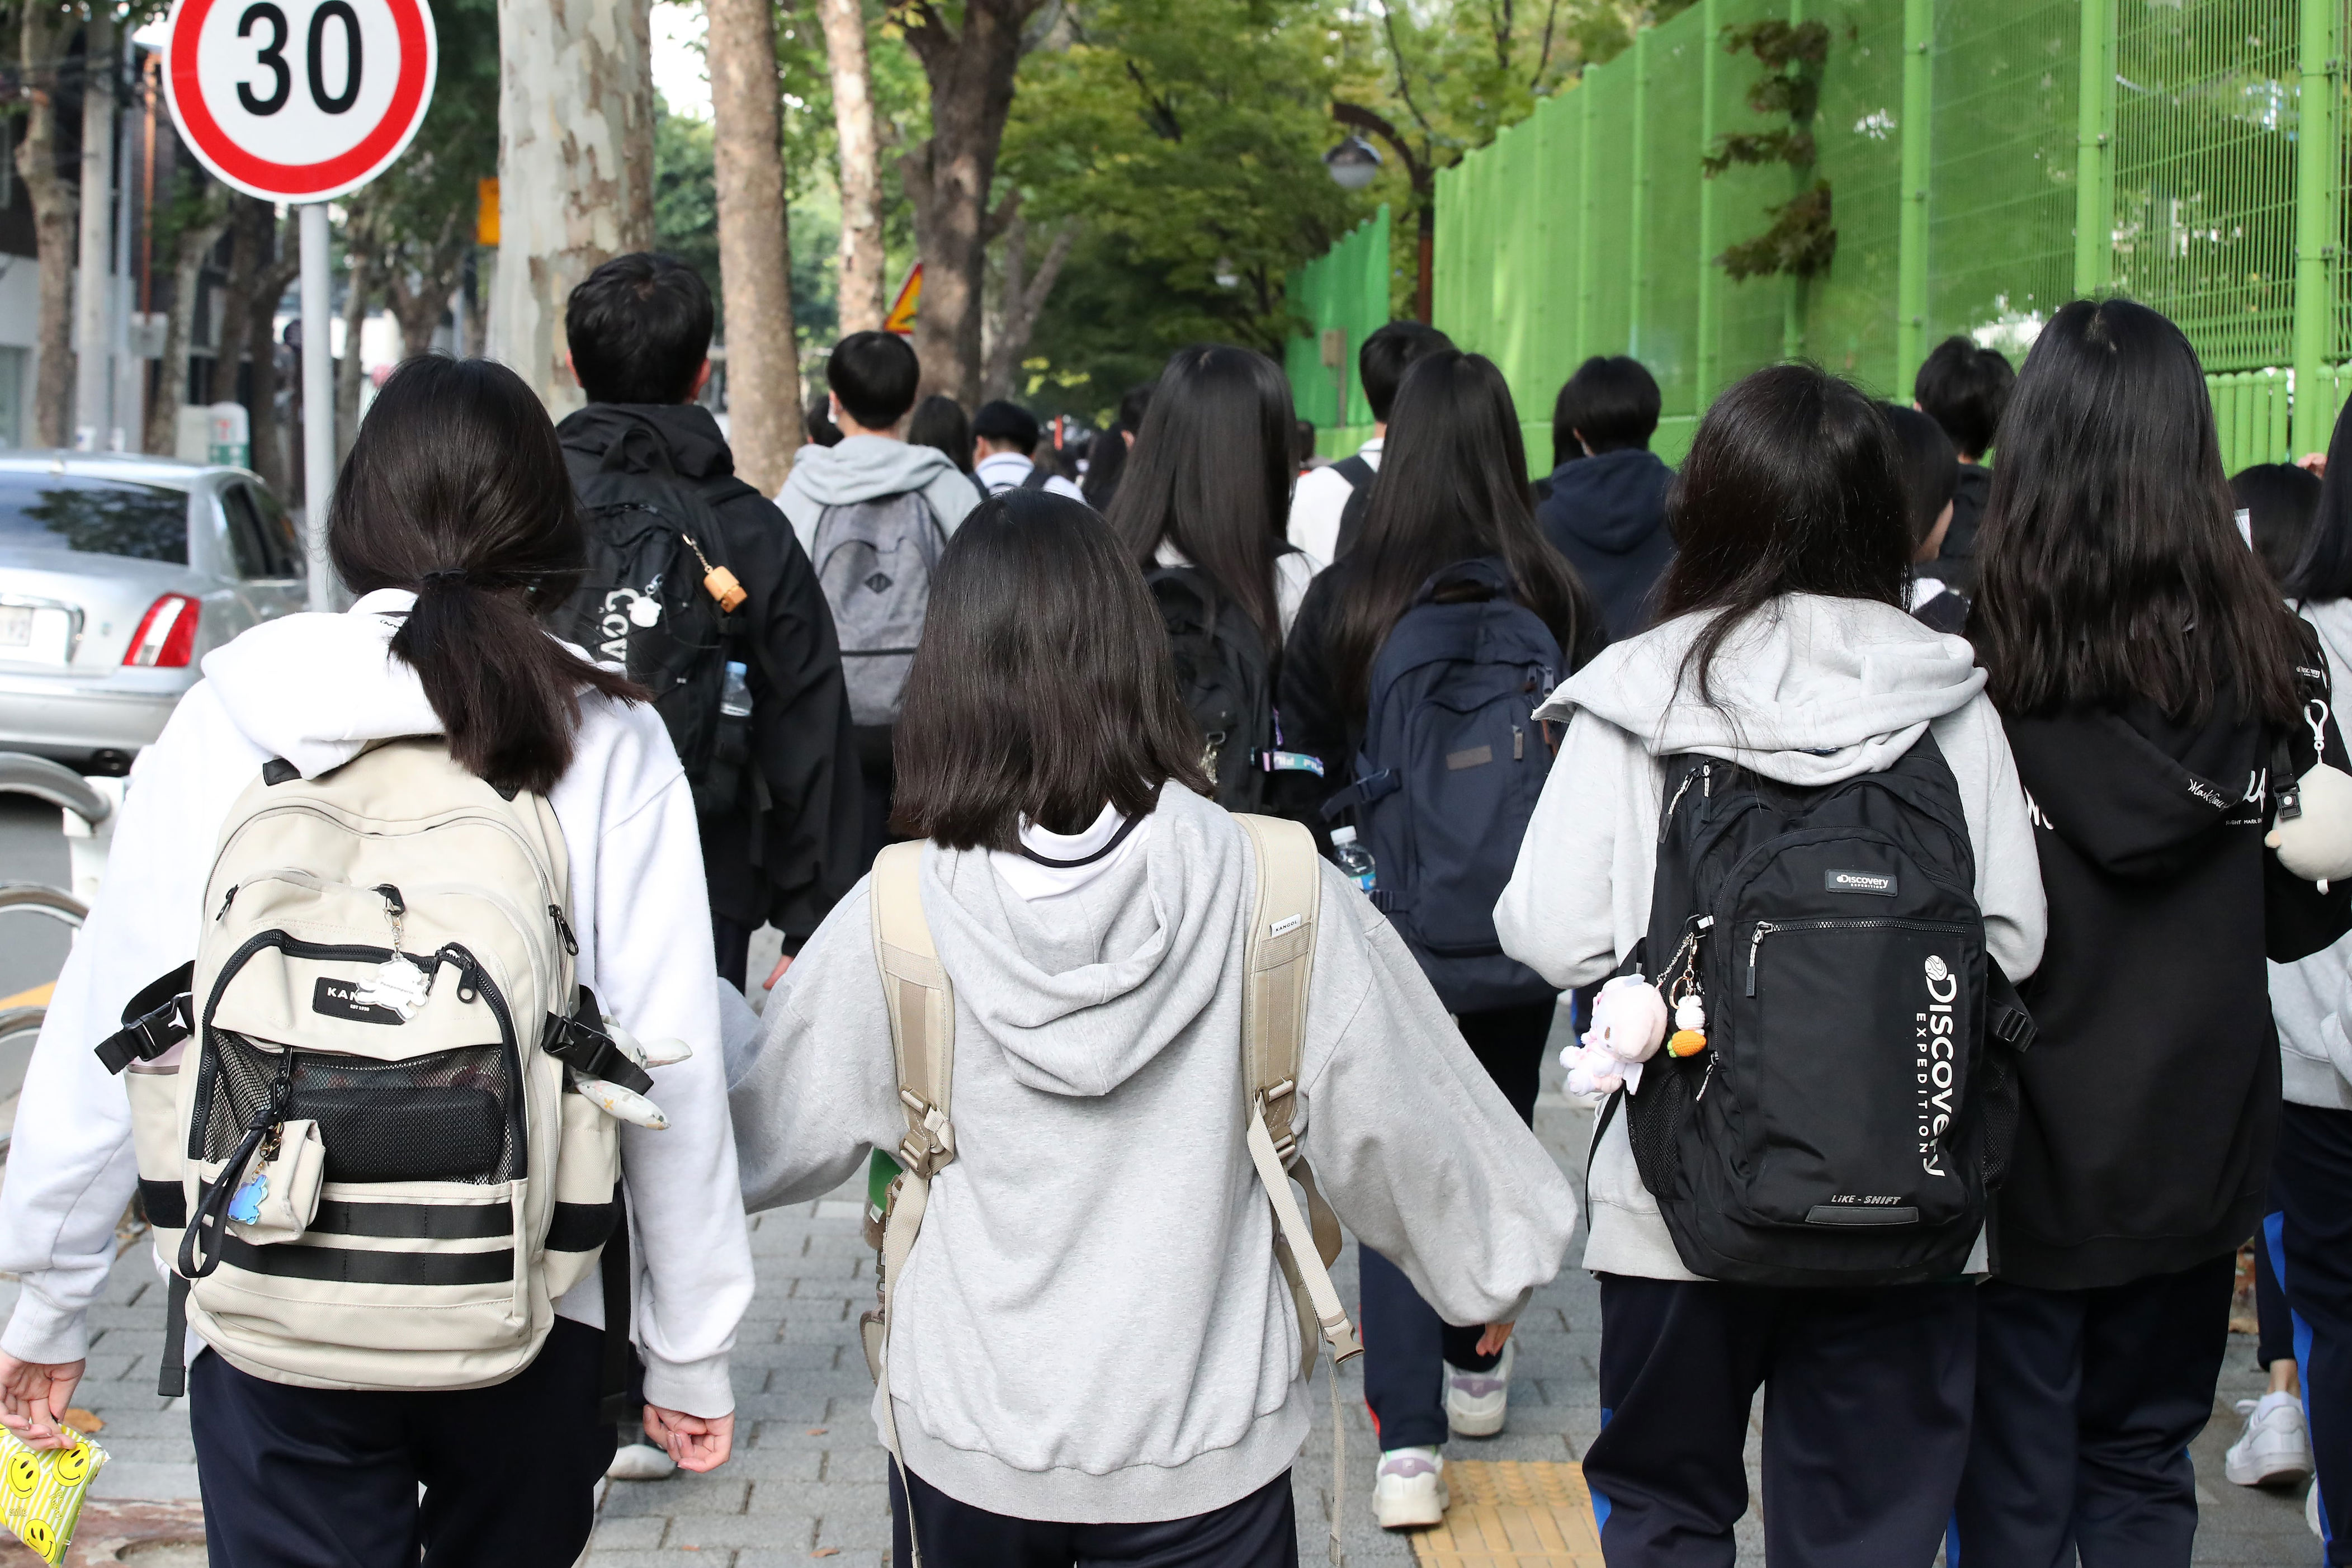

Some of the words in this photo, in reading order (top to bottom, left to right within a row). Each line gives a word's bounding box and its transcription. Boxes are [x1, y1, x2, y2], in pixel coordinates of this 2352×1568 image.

[237, 0, 363, 116] 30
[1276, 920, 1297, 932] KANGOL
[1916, 1013, 1929, 1153] EXPEDITION
